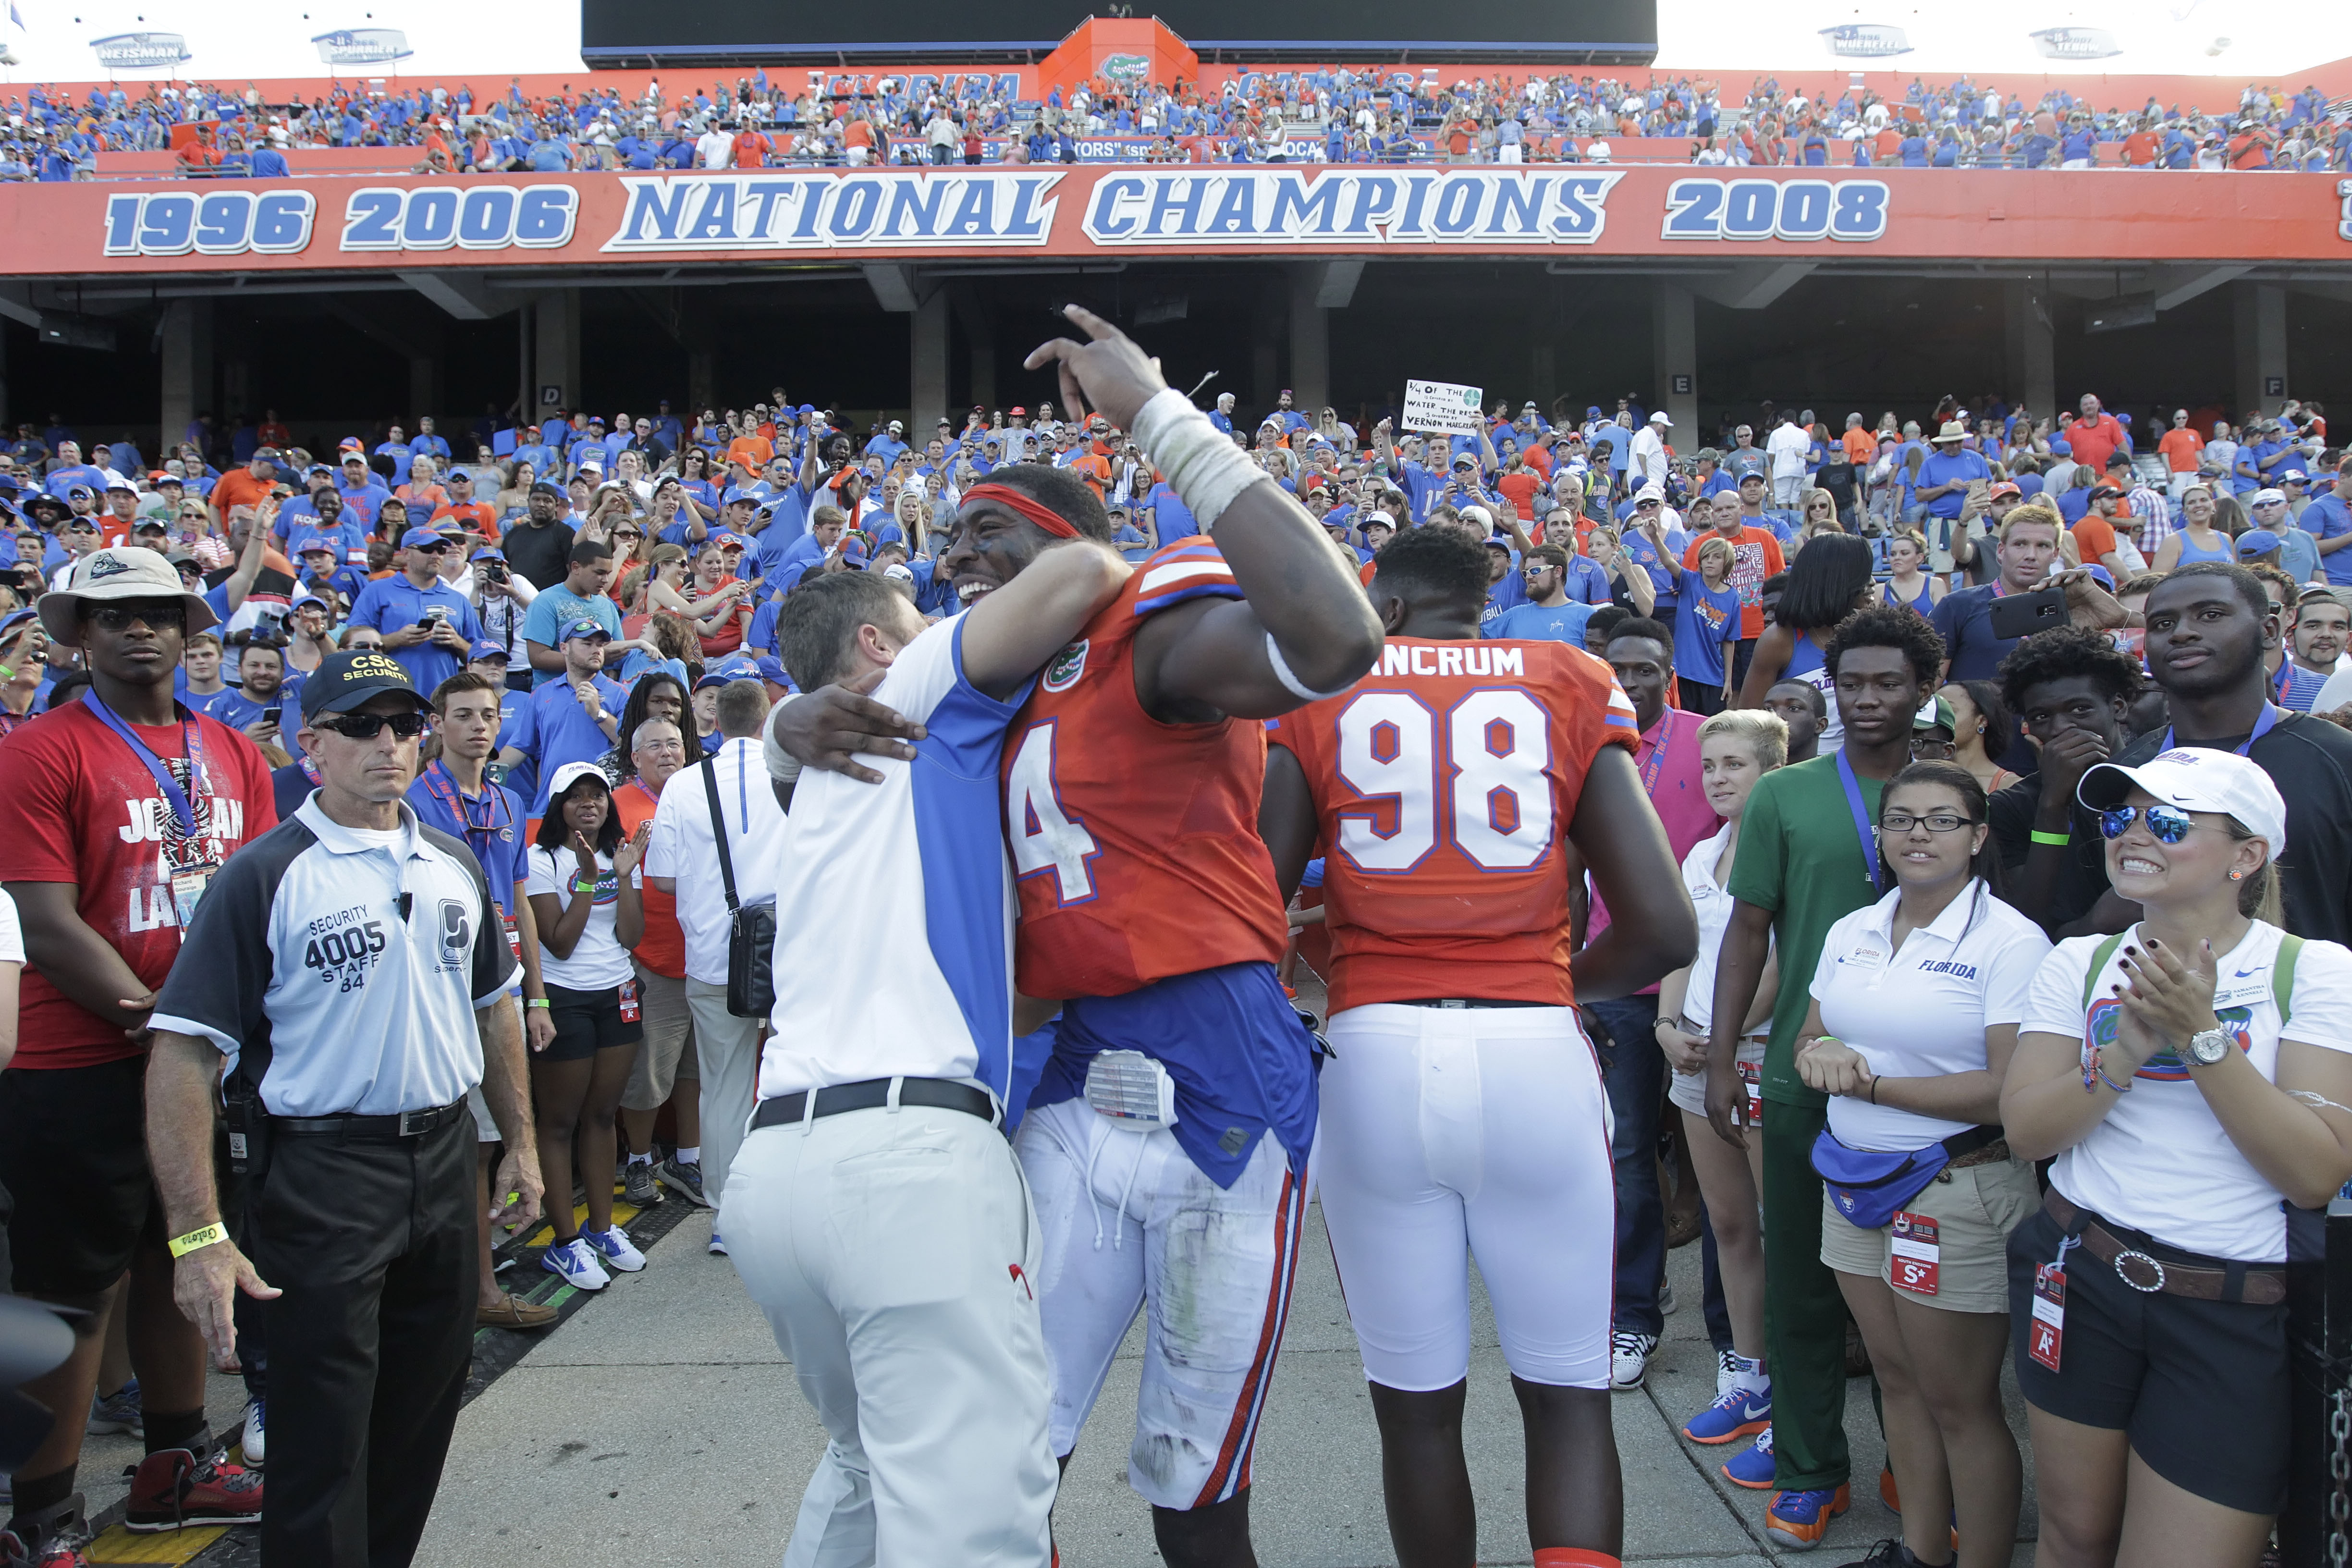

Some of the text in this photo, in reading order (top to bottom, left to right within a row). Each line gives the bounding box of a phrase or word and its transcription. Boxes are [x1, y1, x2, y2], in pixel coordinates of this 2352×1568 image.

[1845, 30, 1851, 38] 7
[331, 45, 396, 54] SPURRIER
[1836, 39, 1899, 49] WUERFFEL
[100, 47, 180, 60] HEISMAN
[1333, 121, 1343, 132] 15
[103, 170, 1890, 257] 1996 2006 NATIONAL CHAMPIONS 2008
[1409, 382, 1463, 396] 3/4 OF THE
[1676, 378, 1688, 392] E
[2269, 380, 2281, 394] F
[544, 388, 559, 404] D
[1406, 416, 1443, 427] VERNON
[351, 654, 400, 672] CSC
[343, 668, 408, 683] SECURITY
[1655, 739, 1665, 756] THE
[192, 747, 201, 766] THE
[567, 765, 596, 773] FLORIDA
[1335, 686, 1556, 874] 98
[438, 781, 464, 823] THE SWAMP
[1005, 715, 1102, 910] 4
[310, 904, 369, 936] SECURITY
[305, 920, 386, 971] 4005
[1855, 947, 1880, 956] FLORIDA
[321, 954, 380, 984] STAFF
[1917, 959, 1977, 980] FLORIDA
[340, 973, 365, 993] 84
[2233, 984, 2265, 993] SAMANTHA
[1912, 1260, 1932, 1269] ENDZONE
[1903, 1265, 1918, 1284] S
[2044, 1326, 2054, 1335] AREAS
[2038, 1331, 2050, 1355] A
